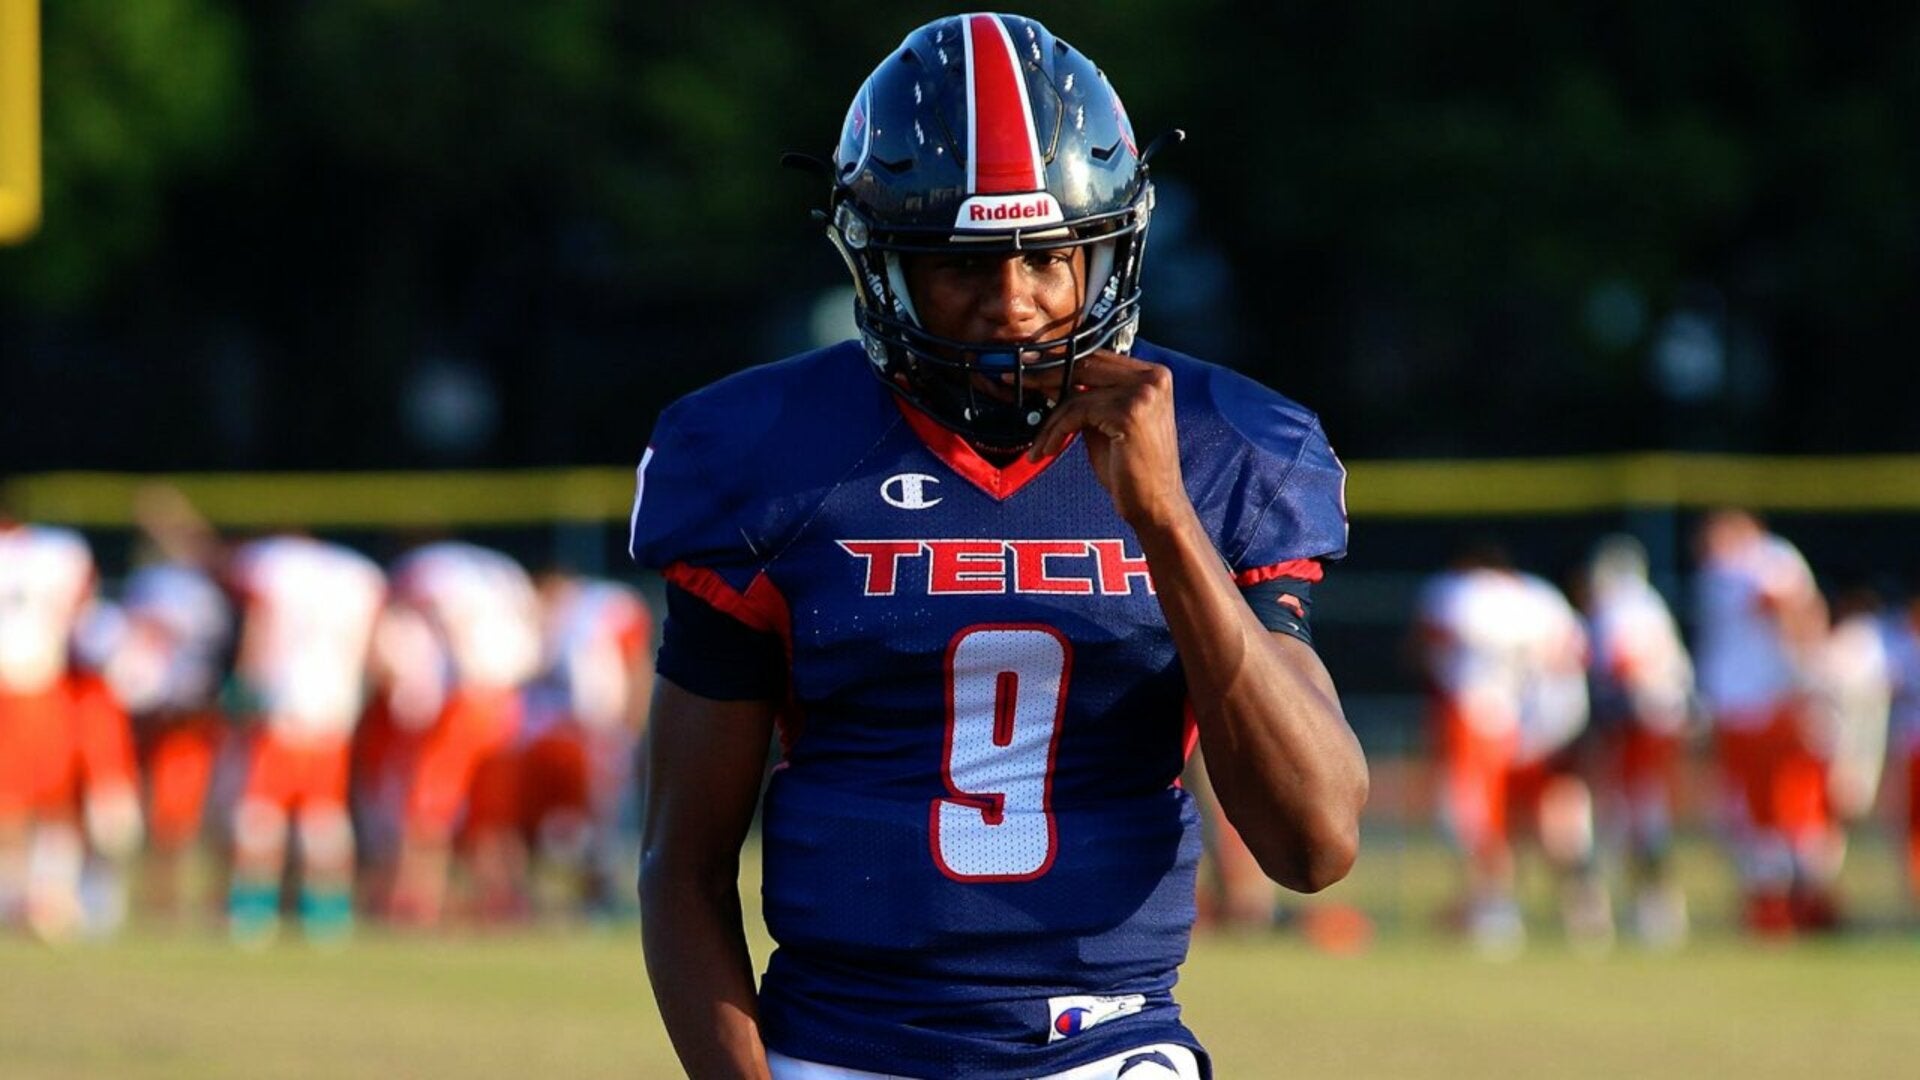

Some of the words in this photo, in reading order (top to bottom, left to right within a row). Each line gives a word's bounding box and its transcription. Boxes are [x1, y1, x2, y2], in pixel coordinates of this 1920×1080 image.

[969, 200, 1050, 221] Riddell
[834, 539, 1157, 596] TECH
[929, 622, 1075, 884] 9
